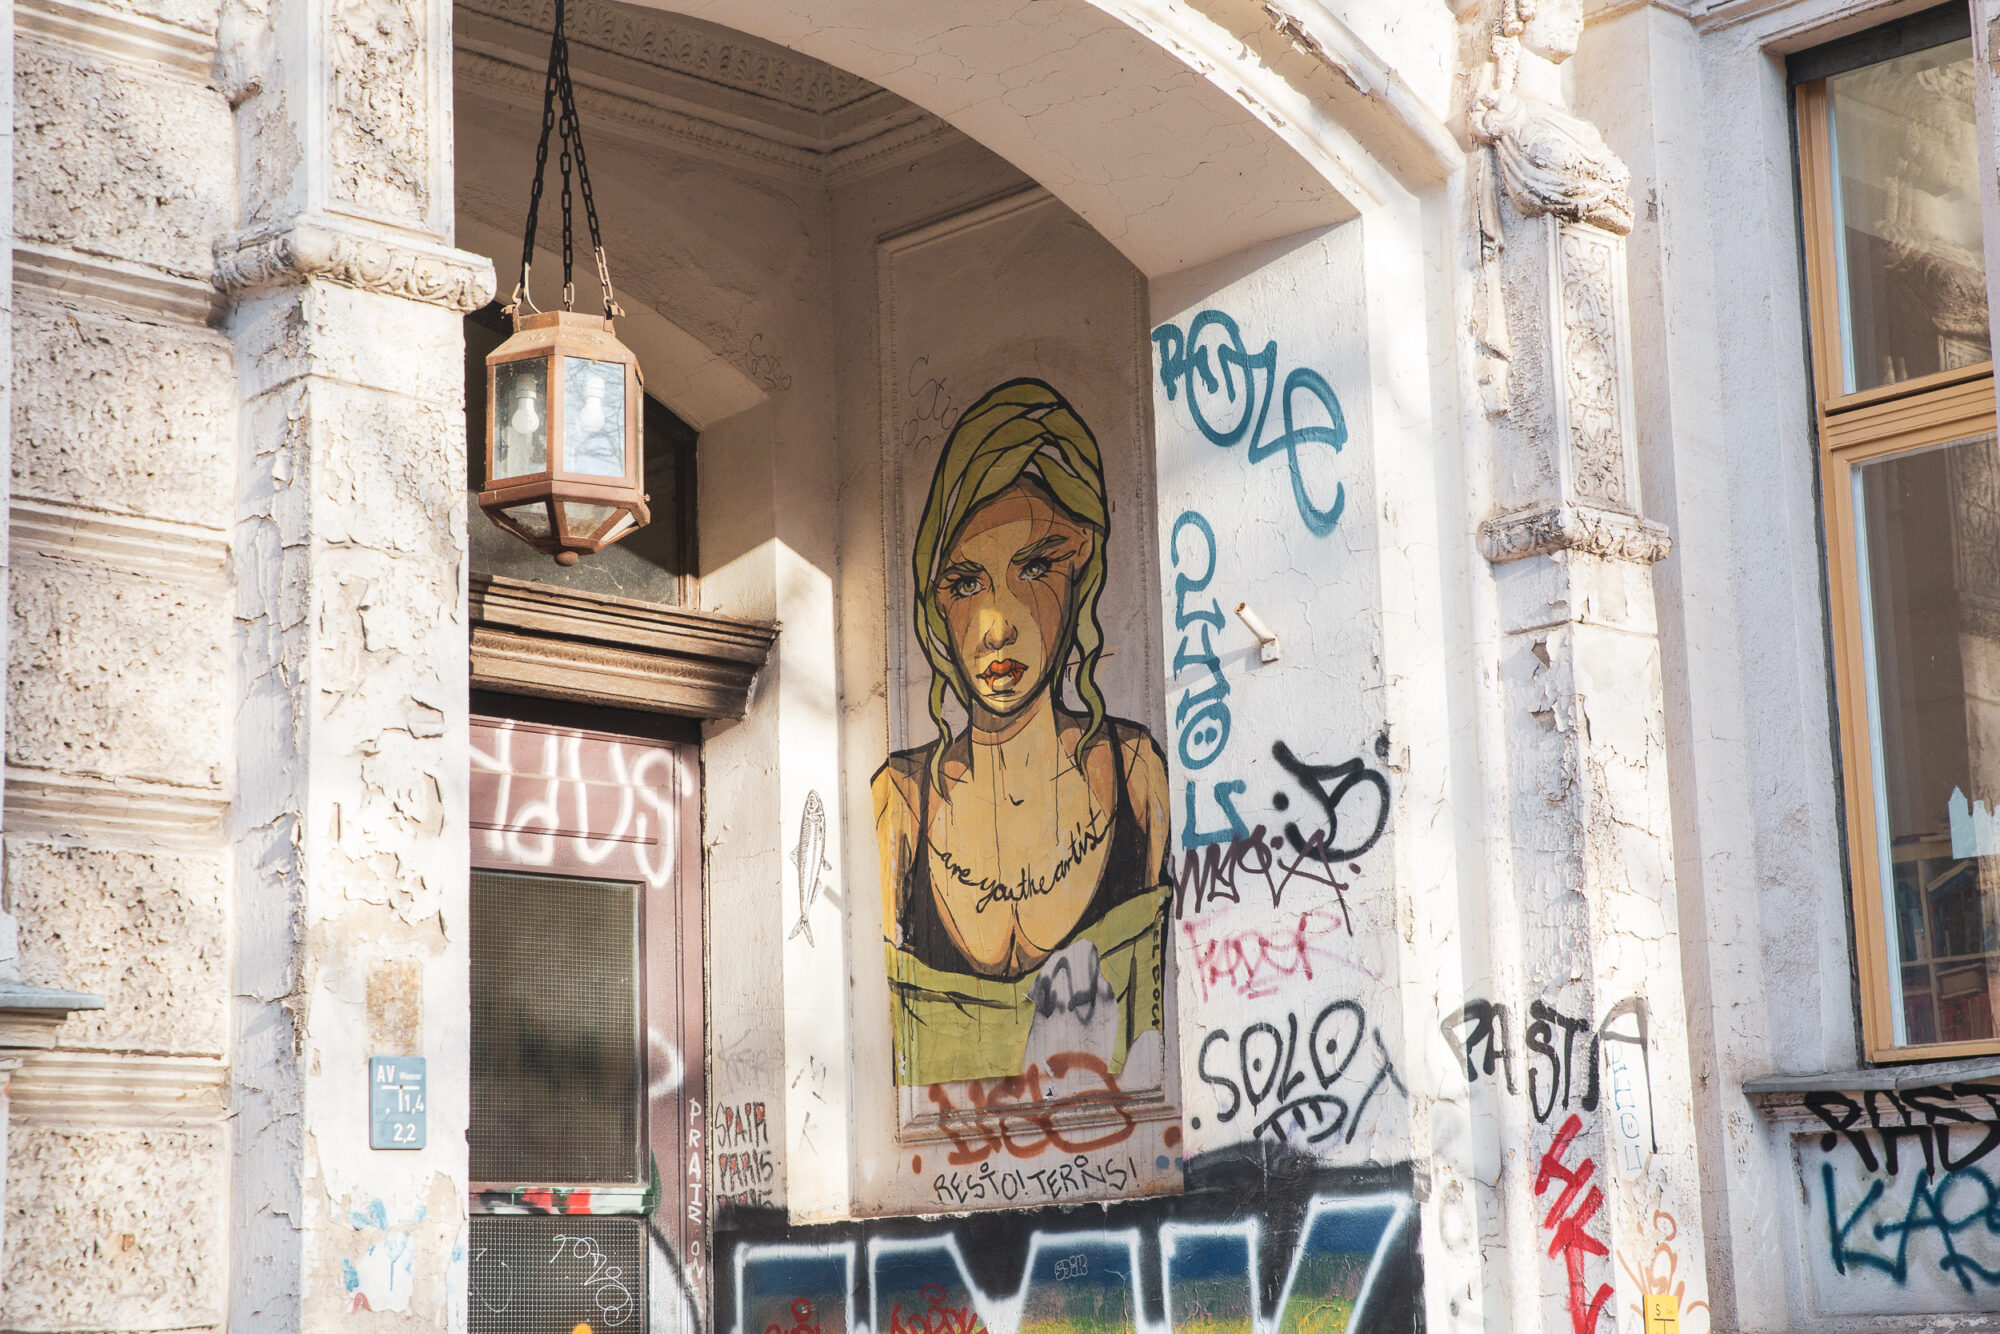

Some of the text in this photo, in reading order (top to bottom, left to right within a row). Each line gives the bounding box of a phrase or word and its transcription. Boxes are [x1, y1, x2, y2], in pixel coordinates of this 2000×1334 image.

[974, 875, 1019, 914] you
[1018, 861, 1051, 902] the
[376, 1065, 395, 1083] AV
[392, 1122, 417, 1145] 2,2
